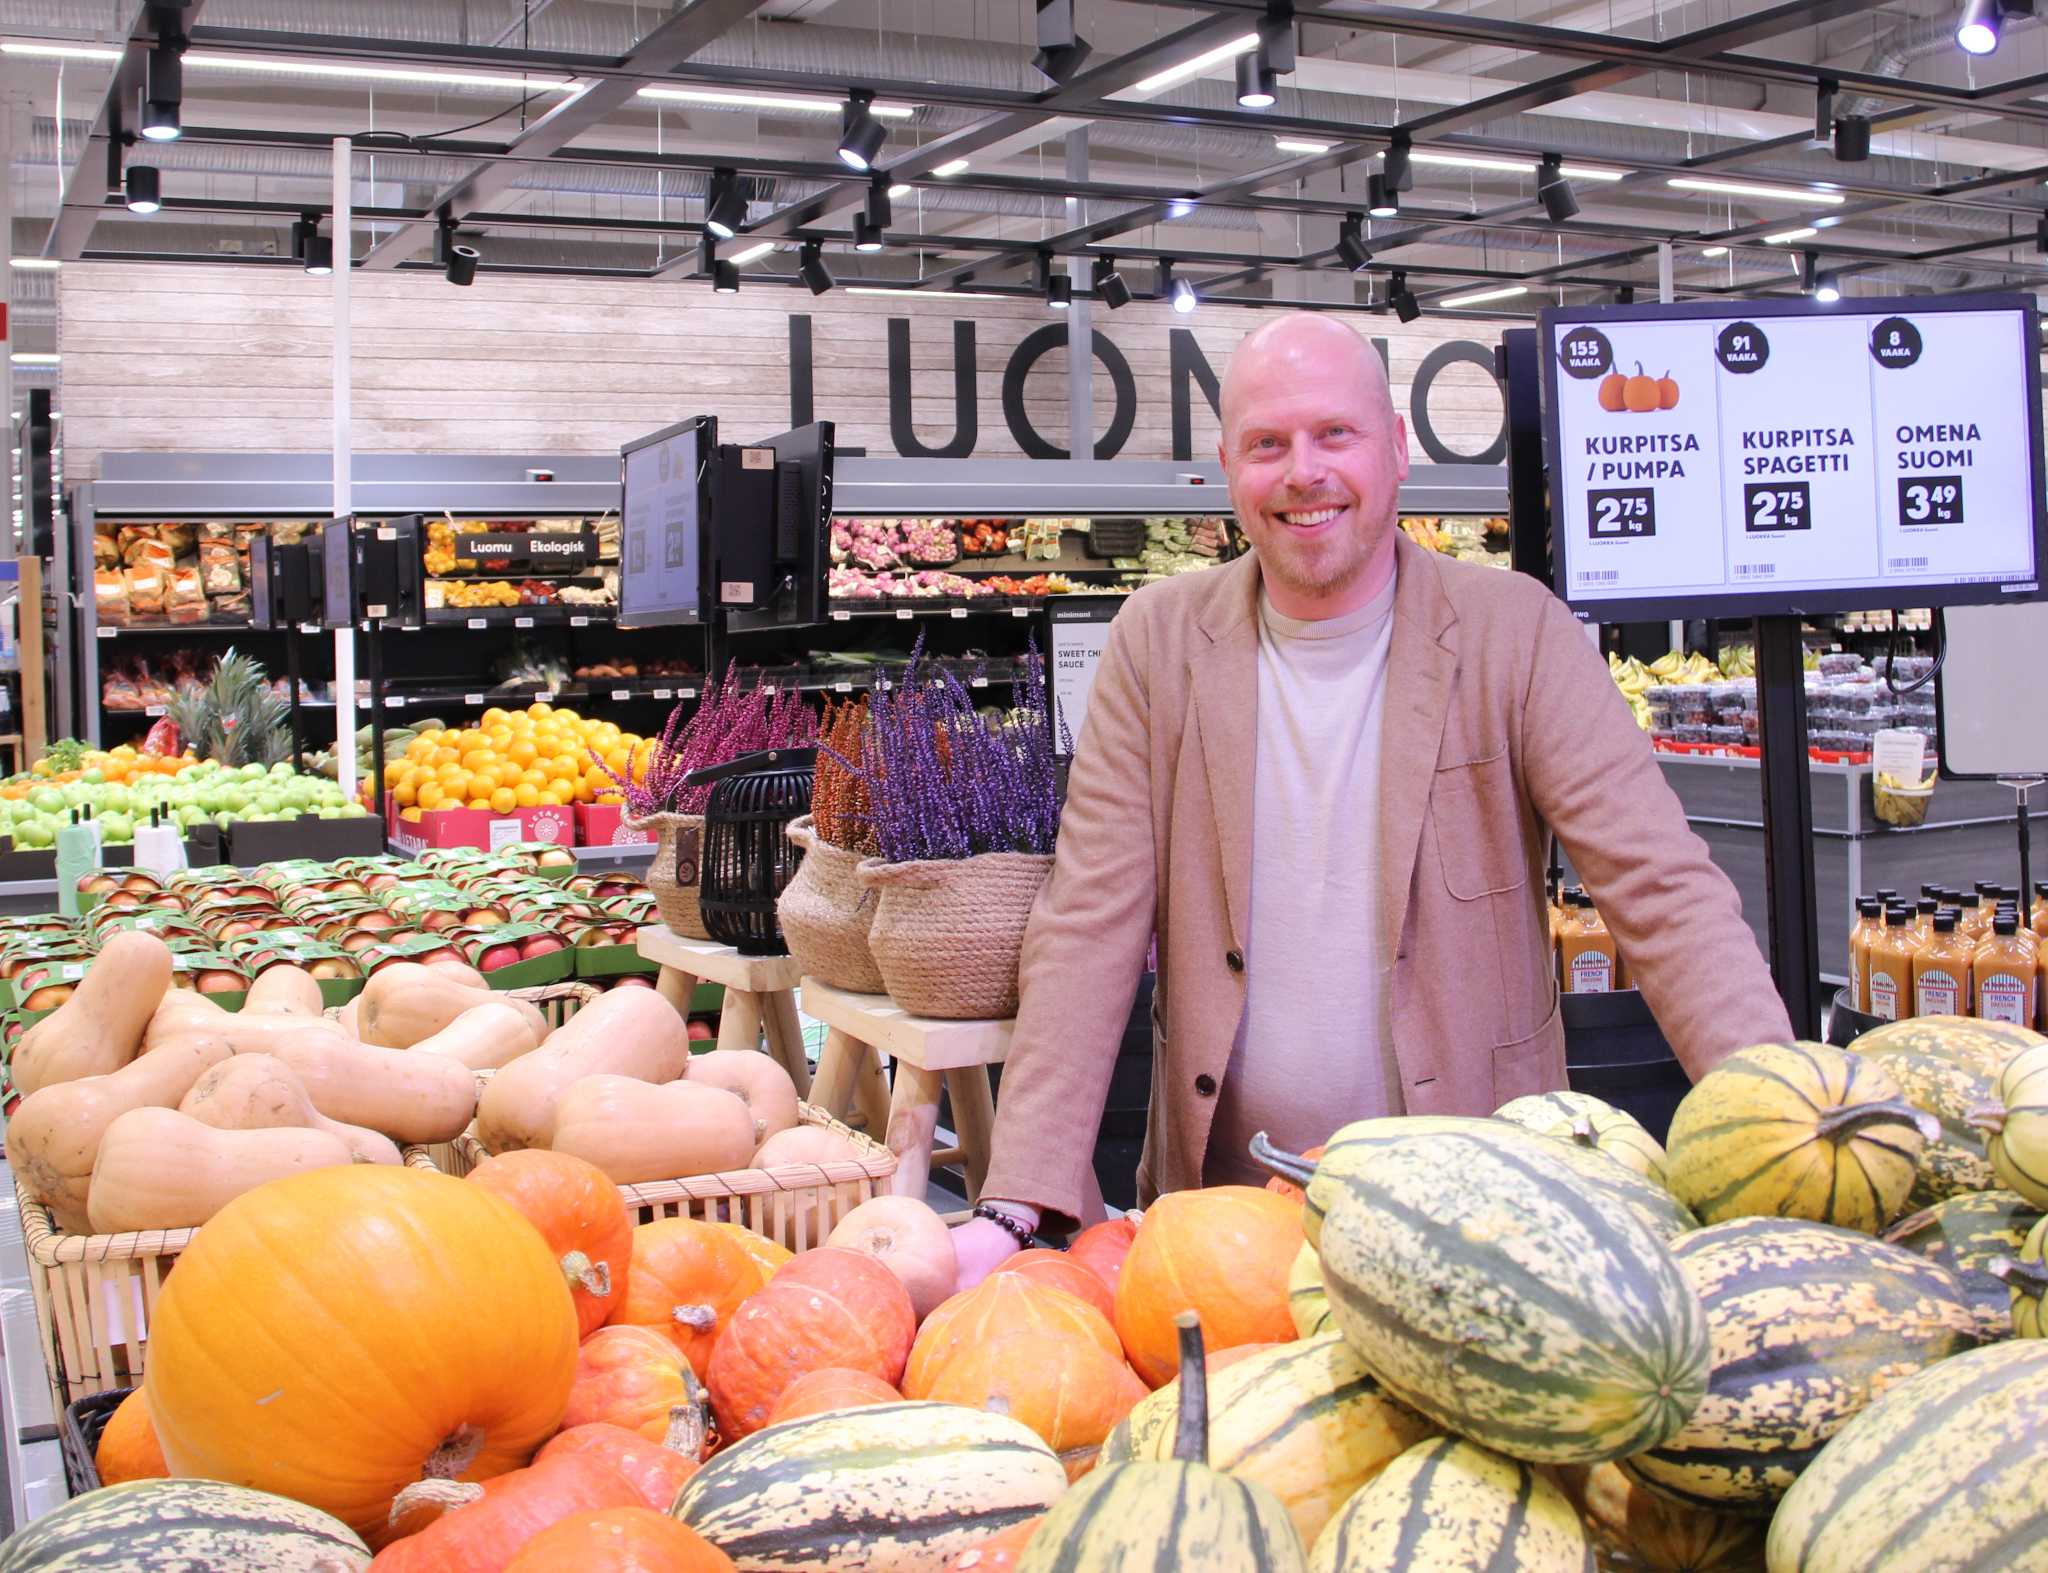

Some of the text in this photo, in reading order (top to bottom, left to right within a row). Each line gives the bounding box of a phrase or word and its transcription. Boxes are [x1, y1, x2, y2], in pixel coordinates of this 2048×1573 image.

[1732, 336, 1750, 351] 91
[1889, 331, 1901, 346] 8
[1569, 341, 1599, 356] 155
[1880, 348, 1911, 357] VAAKA
[1569, 358, 1601, 367] VAAKA
[1726, 353, 1758, 362] VAAKA
[788, 314, 1507, 464] LUONO
[1743, 428, 1855, 449] KURPITSA
[1896, 423, 1981, 444] OMENA
[1586, 434, 1700, 455] KURPITSA
[1744, 454, 1849, 475] SPAGETTI
[1897, 449, 1973, 469] SUOMI
[1602, 460, 1685, 480] PUMPA
[1784, 514, 1799, 526] kg
[1937, 507, 1951, 519] kg
[1628, 520, 1643, 532] kg
[470, 540, 584, 555] Luomu Ekologisk
[528, 810, 565, 828] LETABA
[1580, 970, 1603, 978] FRENCH
[1925, 990, 1947, 998] FRENCH
[1990, 994, 2016, 1002] FRENCH
